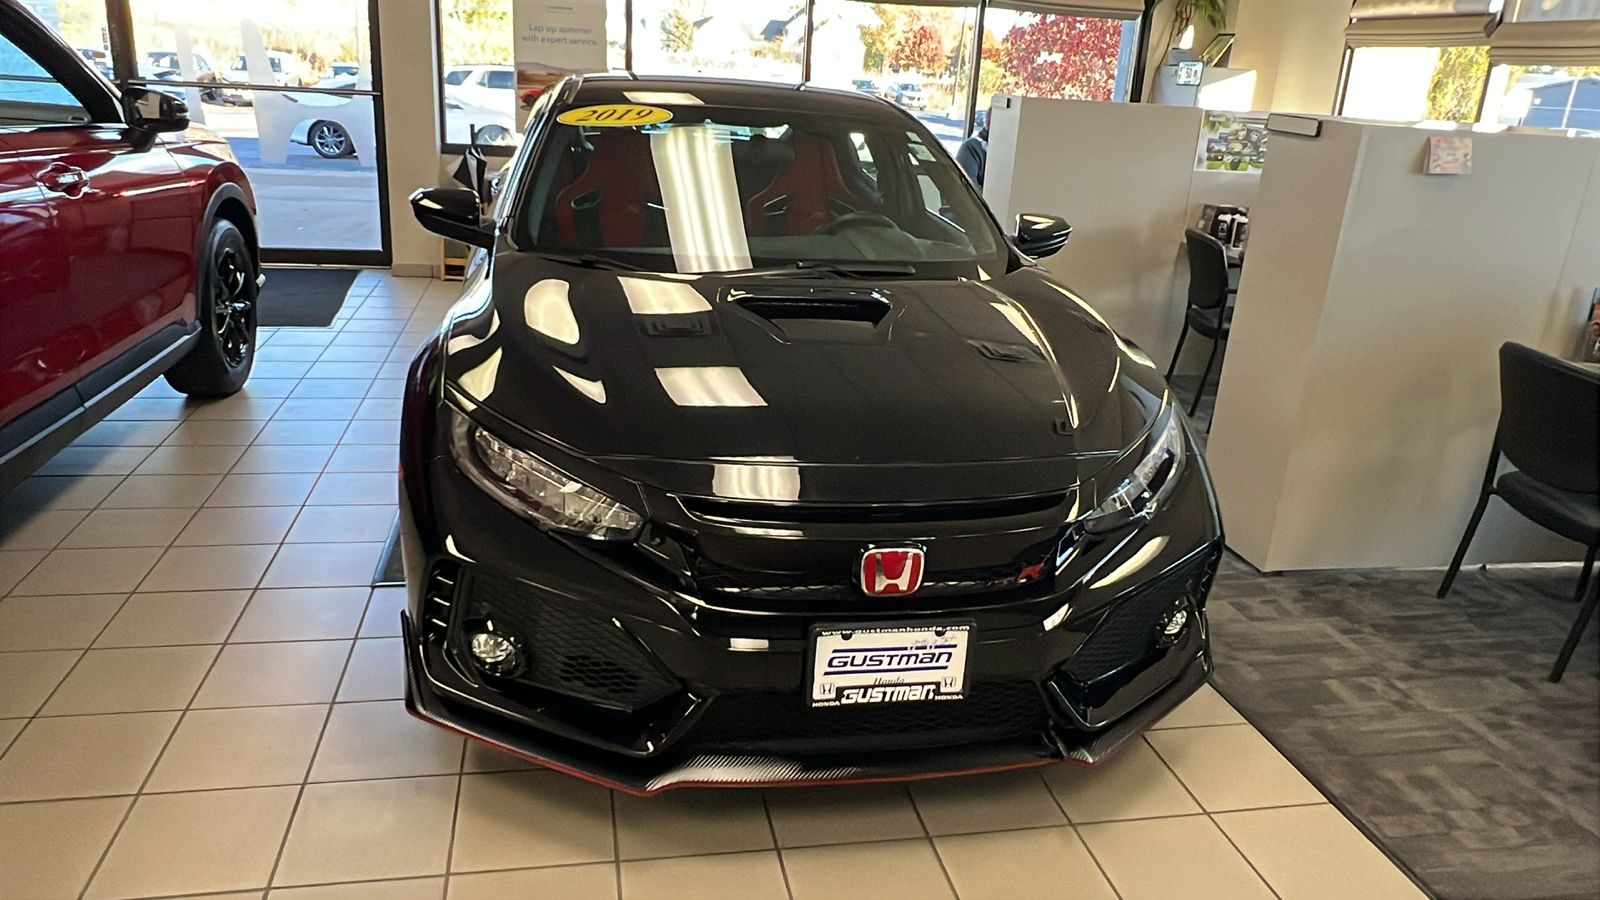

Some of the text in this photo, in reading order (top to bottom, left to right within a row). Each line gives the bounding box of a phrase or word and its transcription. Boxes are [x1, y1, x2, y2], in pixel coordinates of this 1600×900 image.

[528, 23, 592, 35] Lap up summer
[521, 34, 599, 46] with expert service.
[575, 108, 653, 122] 2019
[821, 626, 970, 636] www.gustmanhonda.com
[873, 676, 905, 685] Honda
[812, 700, 840, 708] HONDA
